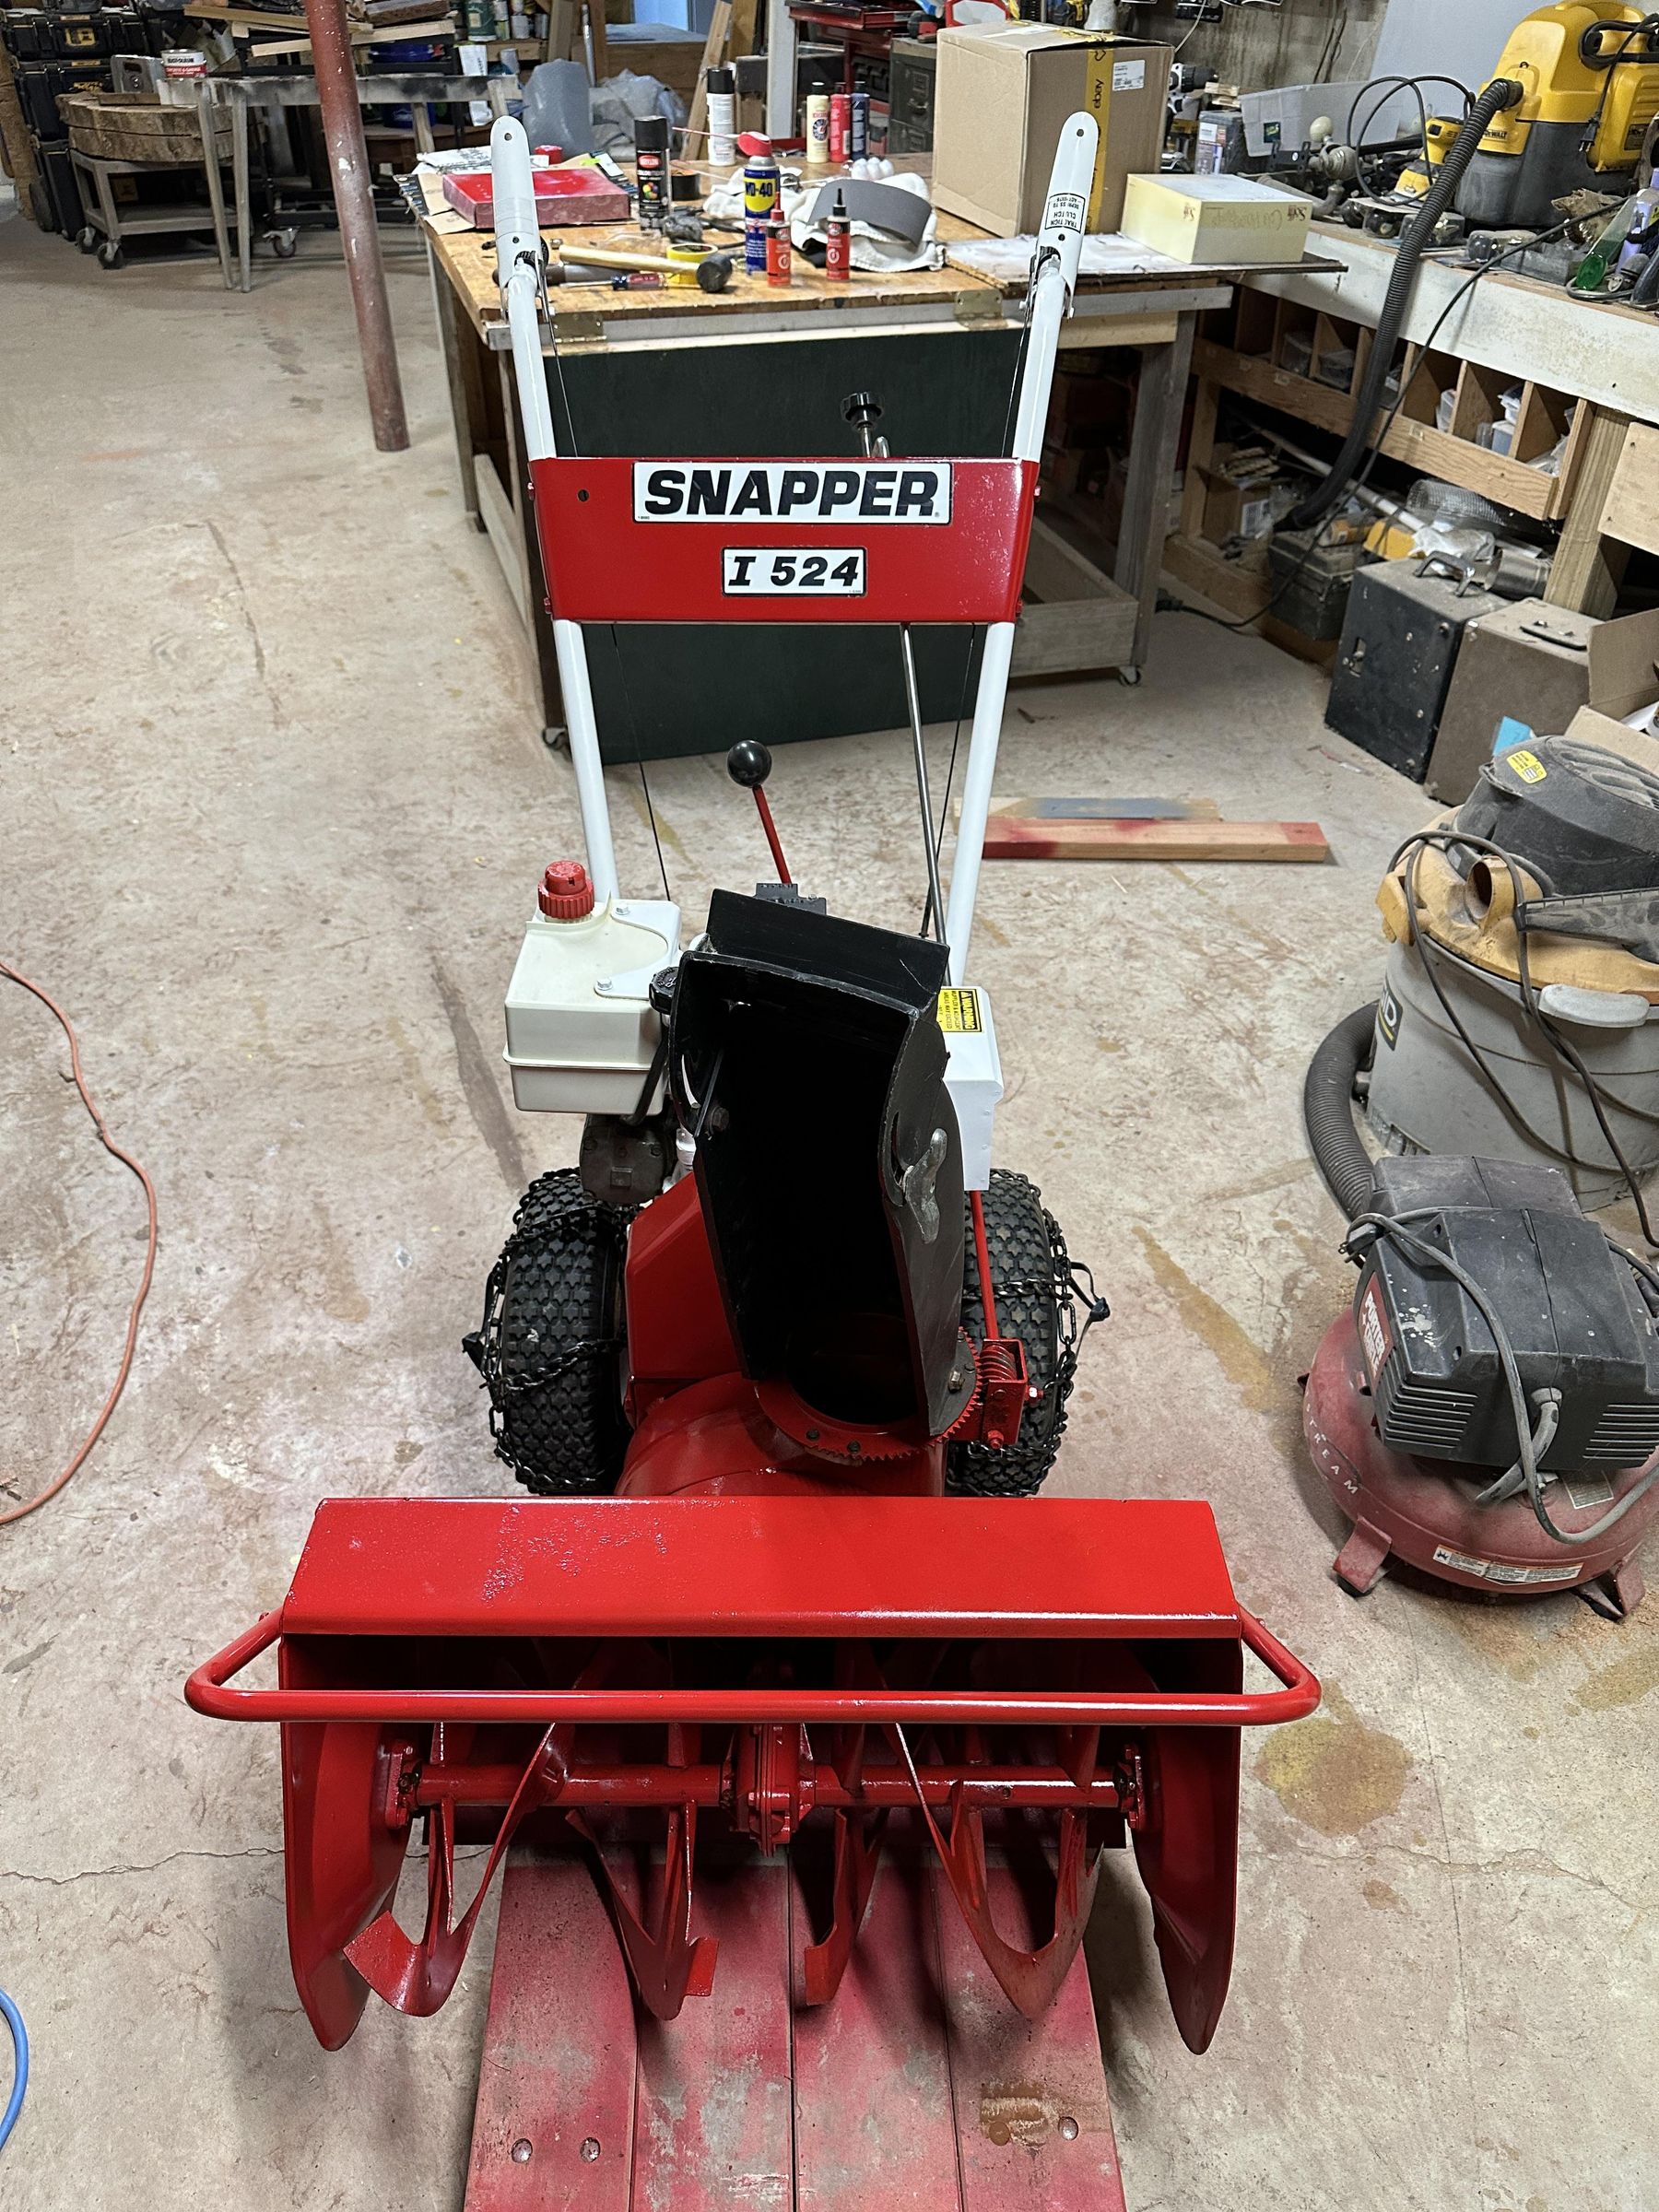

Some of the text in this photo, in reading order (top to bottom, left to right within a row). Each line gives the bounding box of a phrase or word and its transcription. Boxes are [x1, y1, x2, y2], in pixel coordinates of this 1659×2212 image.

[1092, 78, 1104, 109] ebay
[1051, 218, 1077, 228] TRACTION
[1053, 210, 1077, 219] CLUTCH
[645, 470, 937, 516] SNAPPER
[729, 557, 859, 586] I 524
[961, 998, 976, 1029] WARNING
[1365, 1290, 1385, 1361] PORTER
